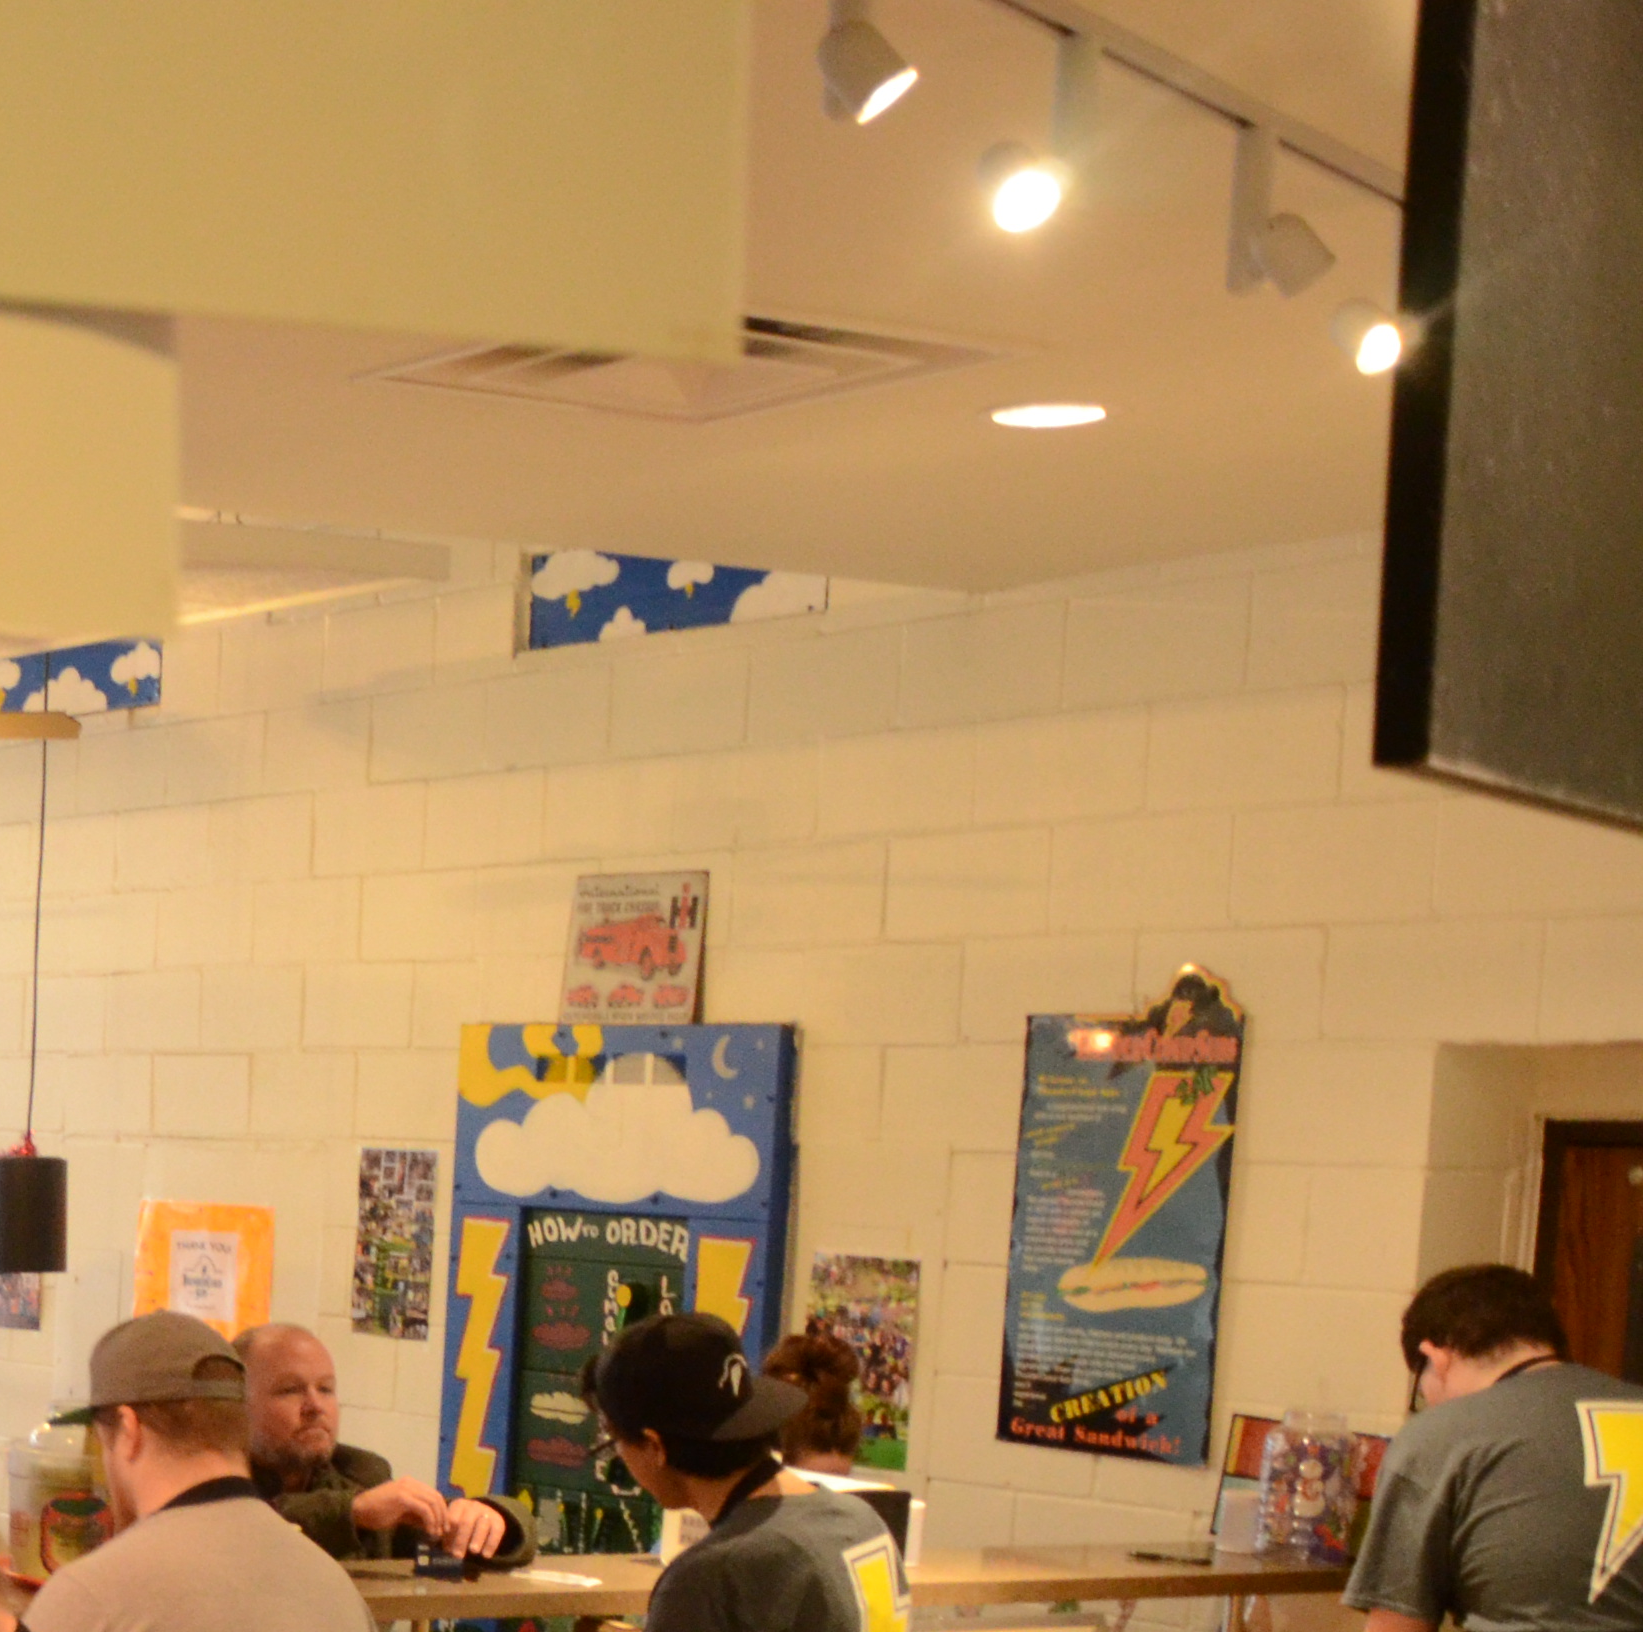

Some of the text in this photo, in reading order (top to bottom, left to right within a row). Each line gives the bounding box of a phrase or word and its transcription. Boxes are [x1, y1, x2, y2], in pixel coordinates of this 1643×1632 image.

[527, 1217, 583, 1249] HOW
[606, 1217, 690, 1263] ORDER
[1049, 1369, 1168, 1424] CREATION
[1010, 1416, 1182, 1454] Great Sandwich!
[1145, 1411, 1160, 1425] a
